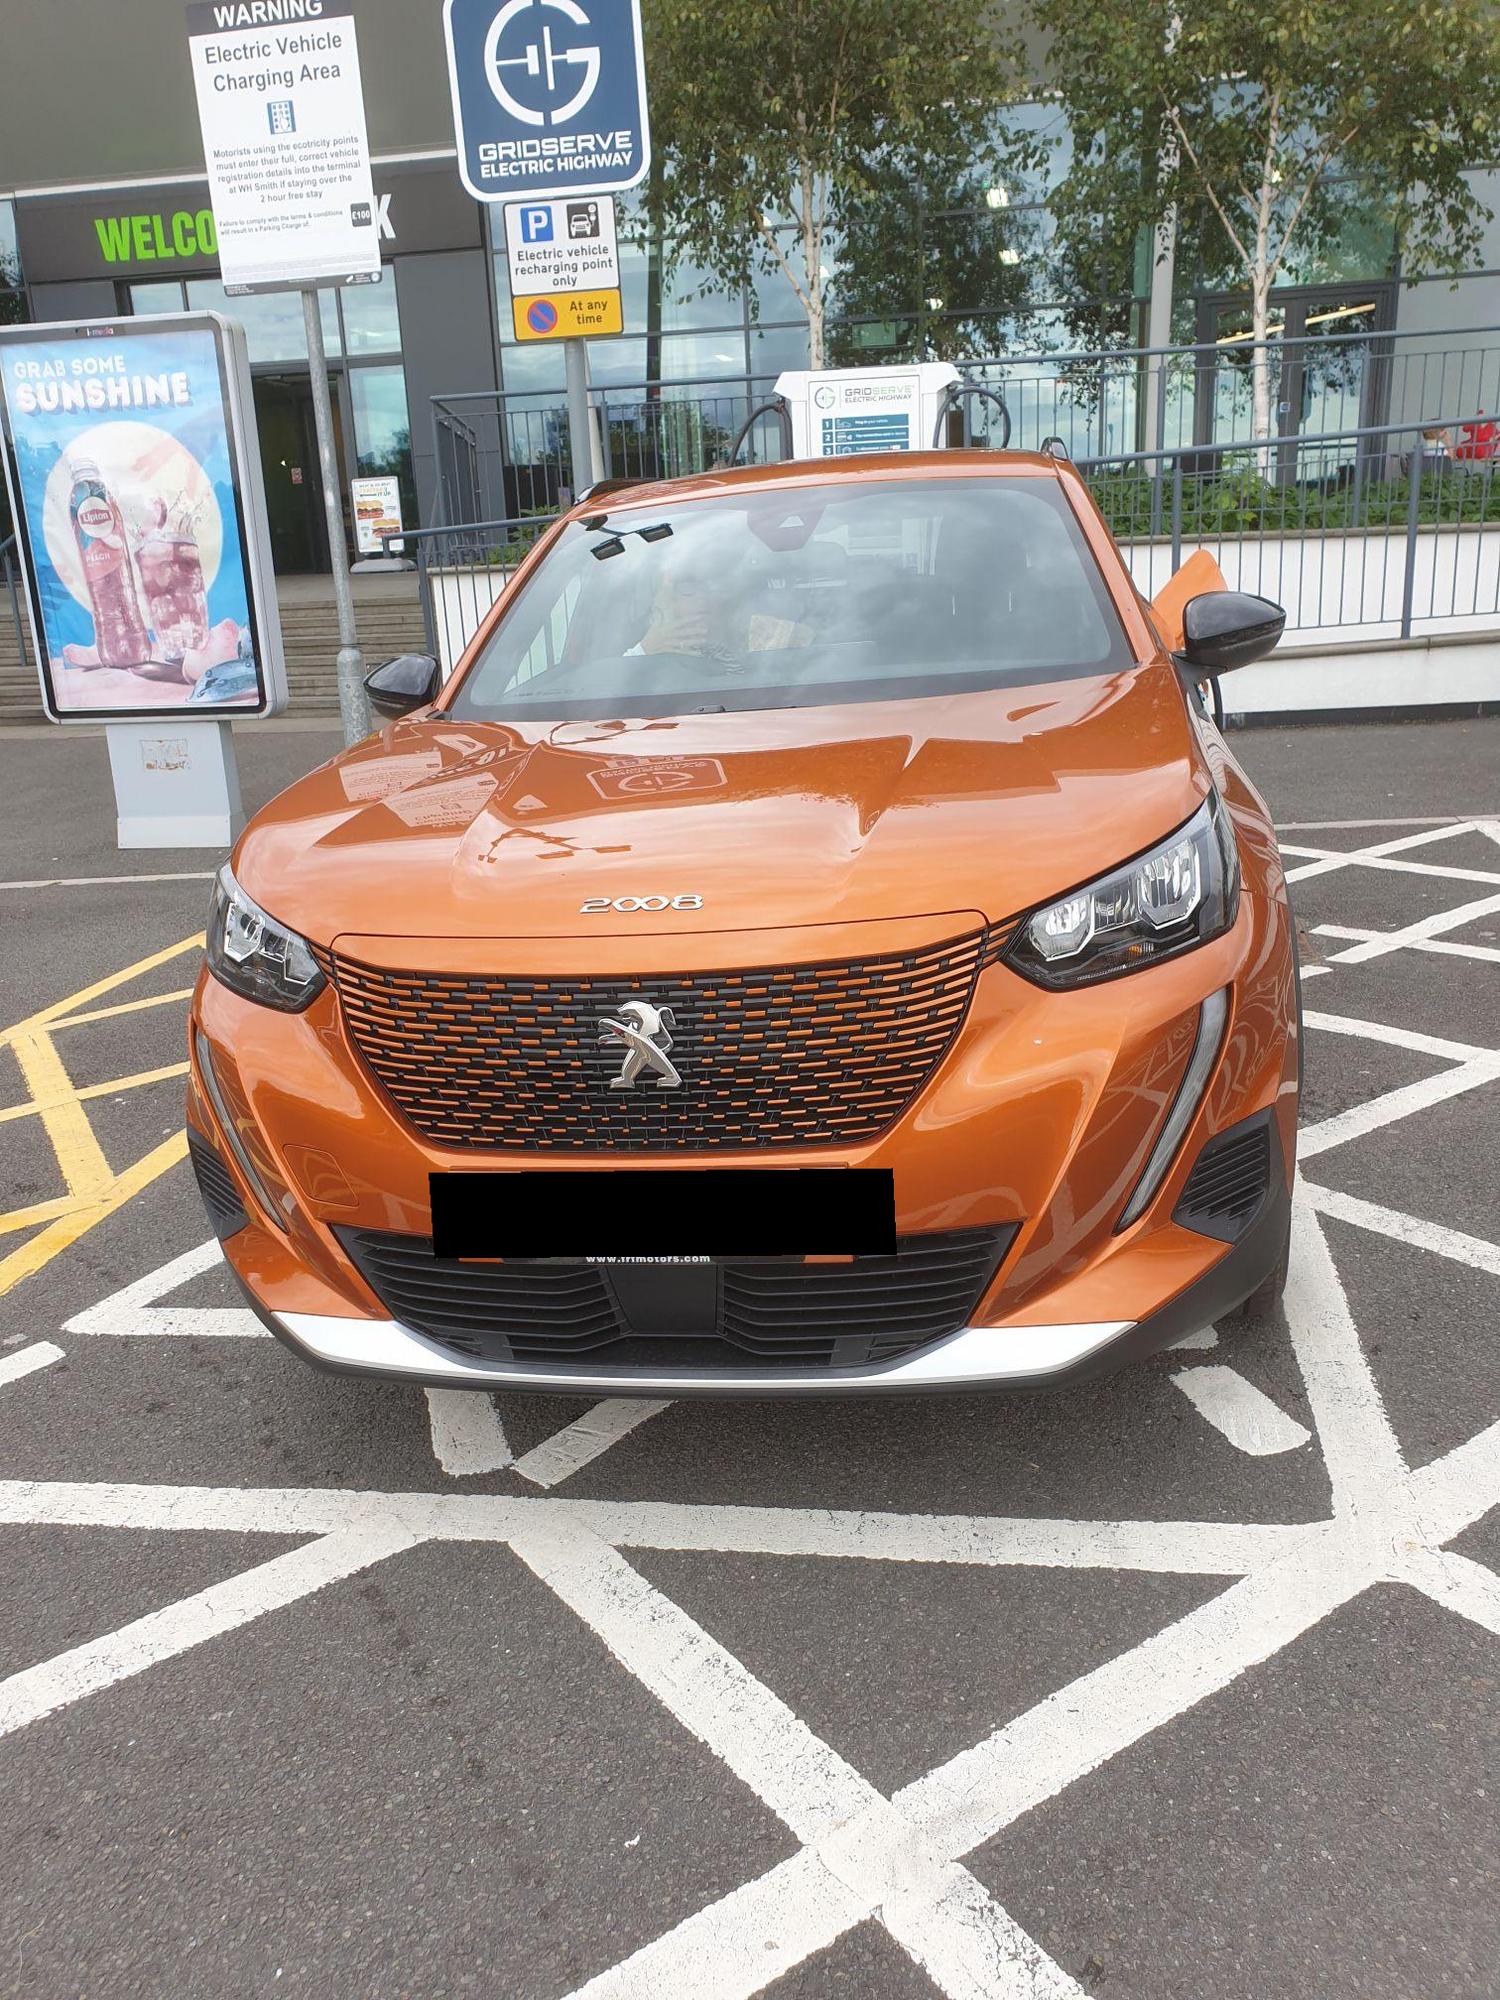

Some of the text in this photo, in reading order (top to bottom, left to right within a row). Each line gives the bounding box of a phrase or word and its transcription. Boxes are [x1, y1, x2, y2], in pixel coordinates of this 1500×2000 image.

[213, 0, 323, 28] WARNING
[205, 32, 342, 64] Electric Vehicle
[213, 64, 341, 91] Charging Area
[213, 135, 359, 158] Motorists using the ecotricity points
[478, 131, 633, 161] GRIDSERVE
[216, 162, 237, 171] must
[239, 160, 259, 169] enter
[261, 157, 279, 167] their
[299, 152, 328, 162] correct
[330, 148, 359, 159] vehicle
[481, 151, 632, 178] ELECTRIC HIGHWAY
[217, 160, 361, 184] registration details into the terminal
[229, 174, 352, 194] at WH Smith if staying over the
[260, 189, 323, 203] 2 hour free stay
[352, 210, 370, 219] £100
[528, 210, 548, 239] P
[95, 209, 219, 263] WELCO
[517, 244, 609, 261] Electric vehicle
[515, 257, 613, 275] recharging point
[552, 275, 577, 287] only
[570, 300, 608, 311] At any
[577, 314, 602, 325] time
[13, 355, 126, 378] GRAB SOME
[15, 371, 192, 414] SUNSHINE
[845, 385, 912, 397] GRIDSERVE
[845, 394, 912, 404] ELECTRIC HIGHWAY
[83, 511, 109, 524] Lipton
[580, 894, 703, 914] 2008
